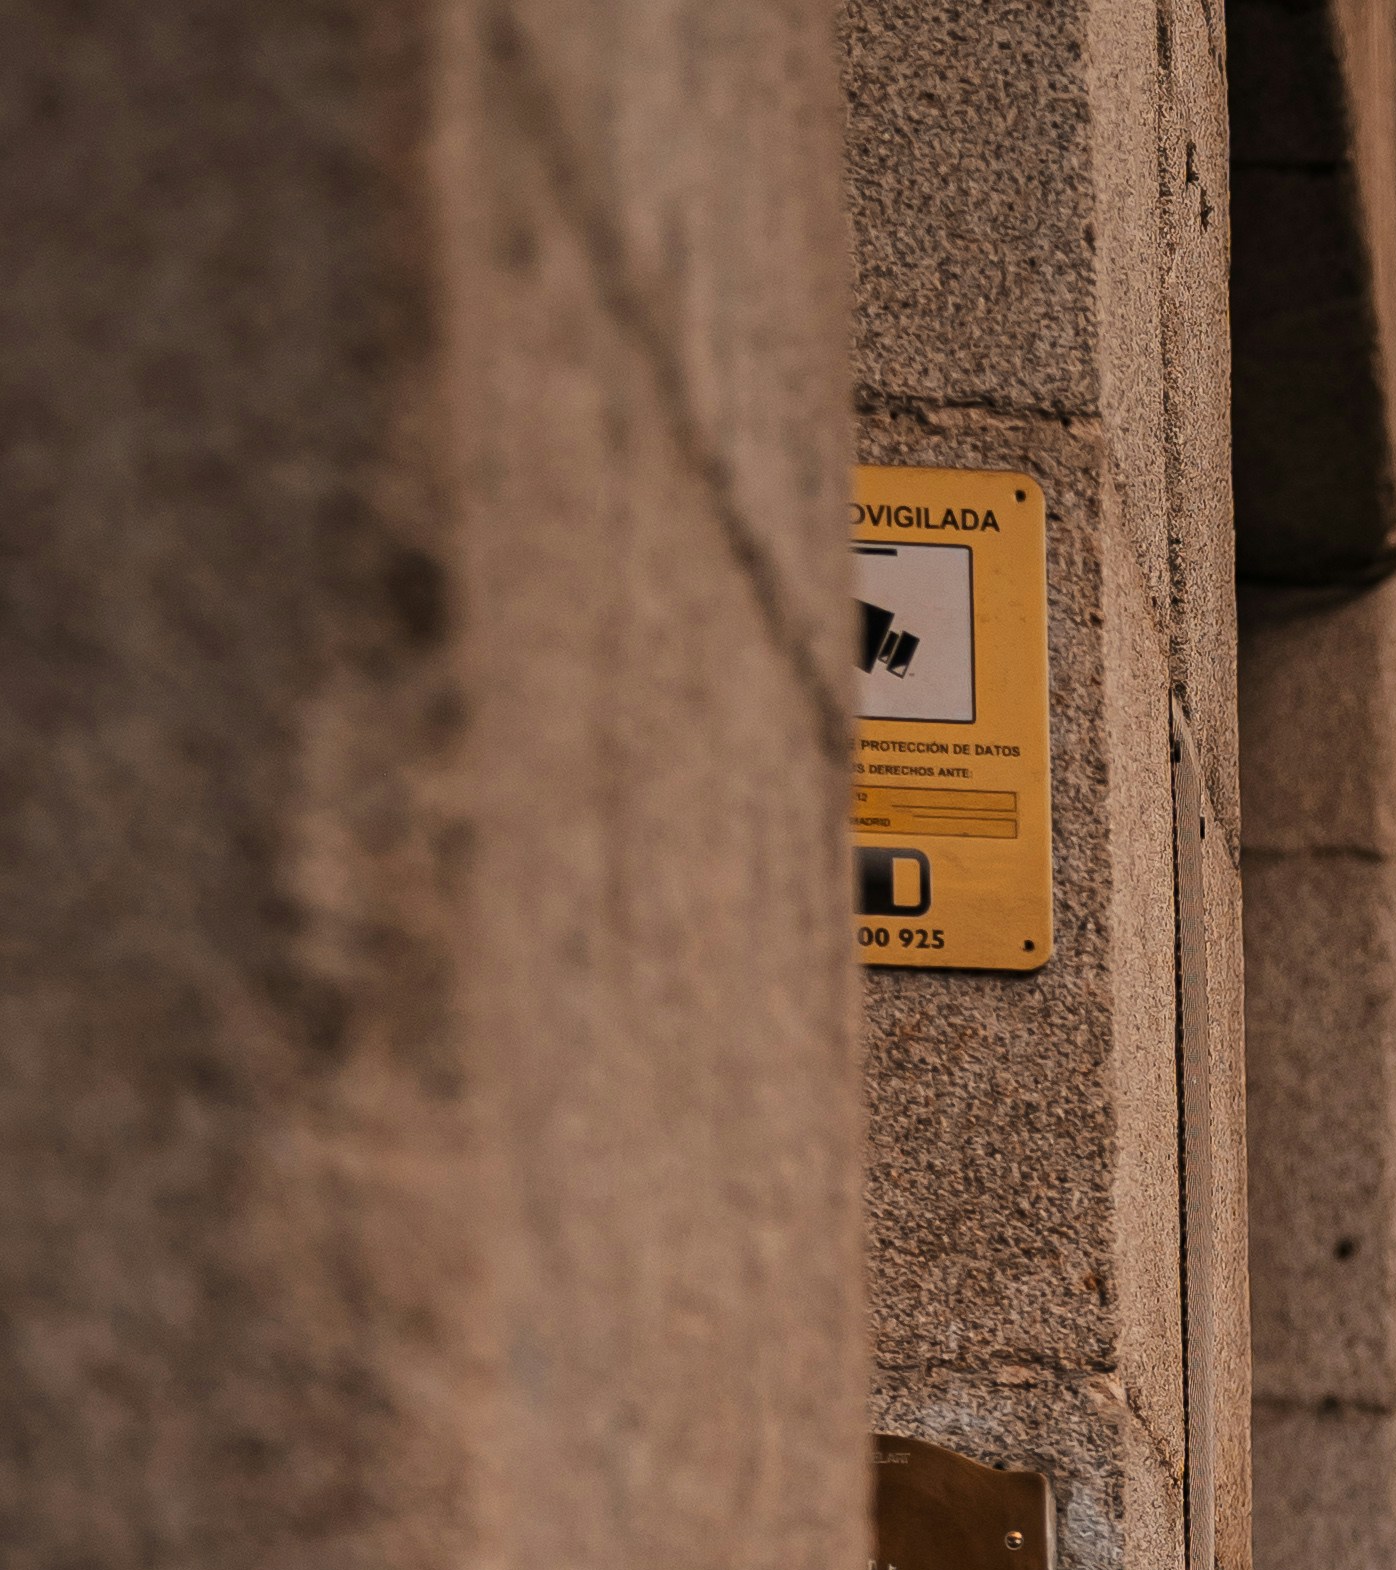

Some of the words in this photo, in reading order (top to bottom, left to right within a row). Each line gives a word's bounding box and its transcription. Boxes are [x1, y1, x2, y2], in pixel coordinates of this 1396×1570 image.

[861, 739, 948, 754] PROTECCIÓN
[953, 743, 970, 755] DE
[975, 744, 1021, 757] DATOS
[869, 764, 934, 777] DERECHOS
[898, 927, 945, 949] 925
